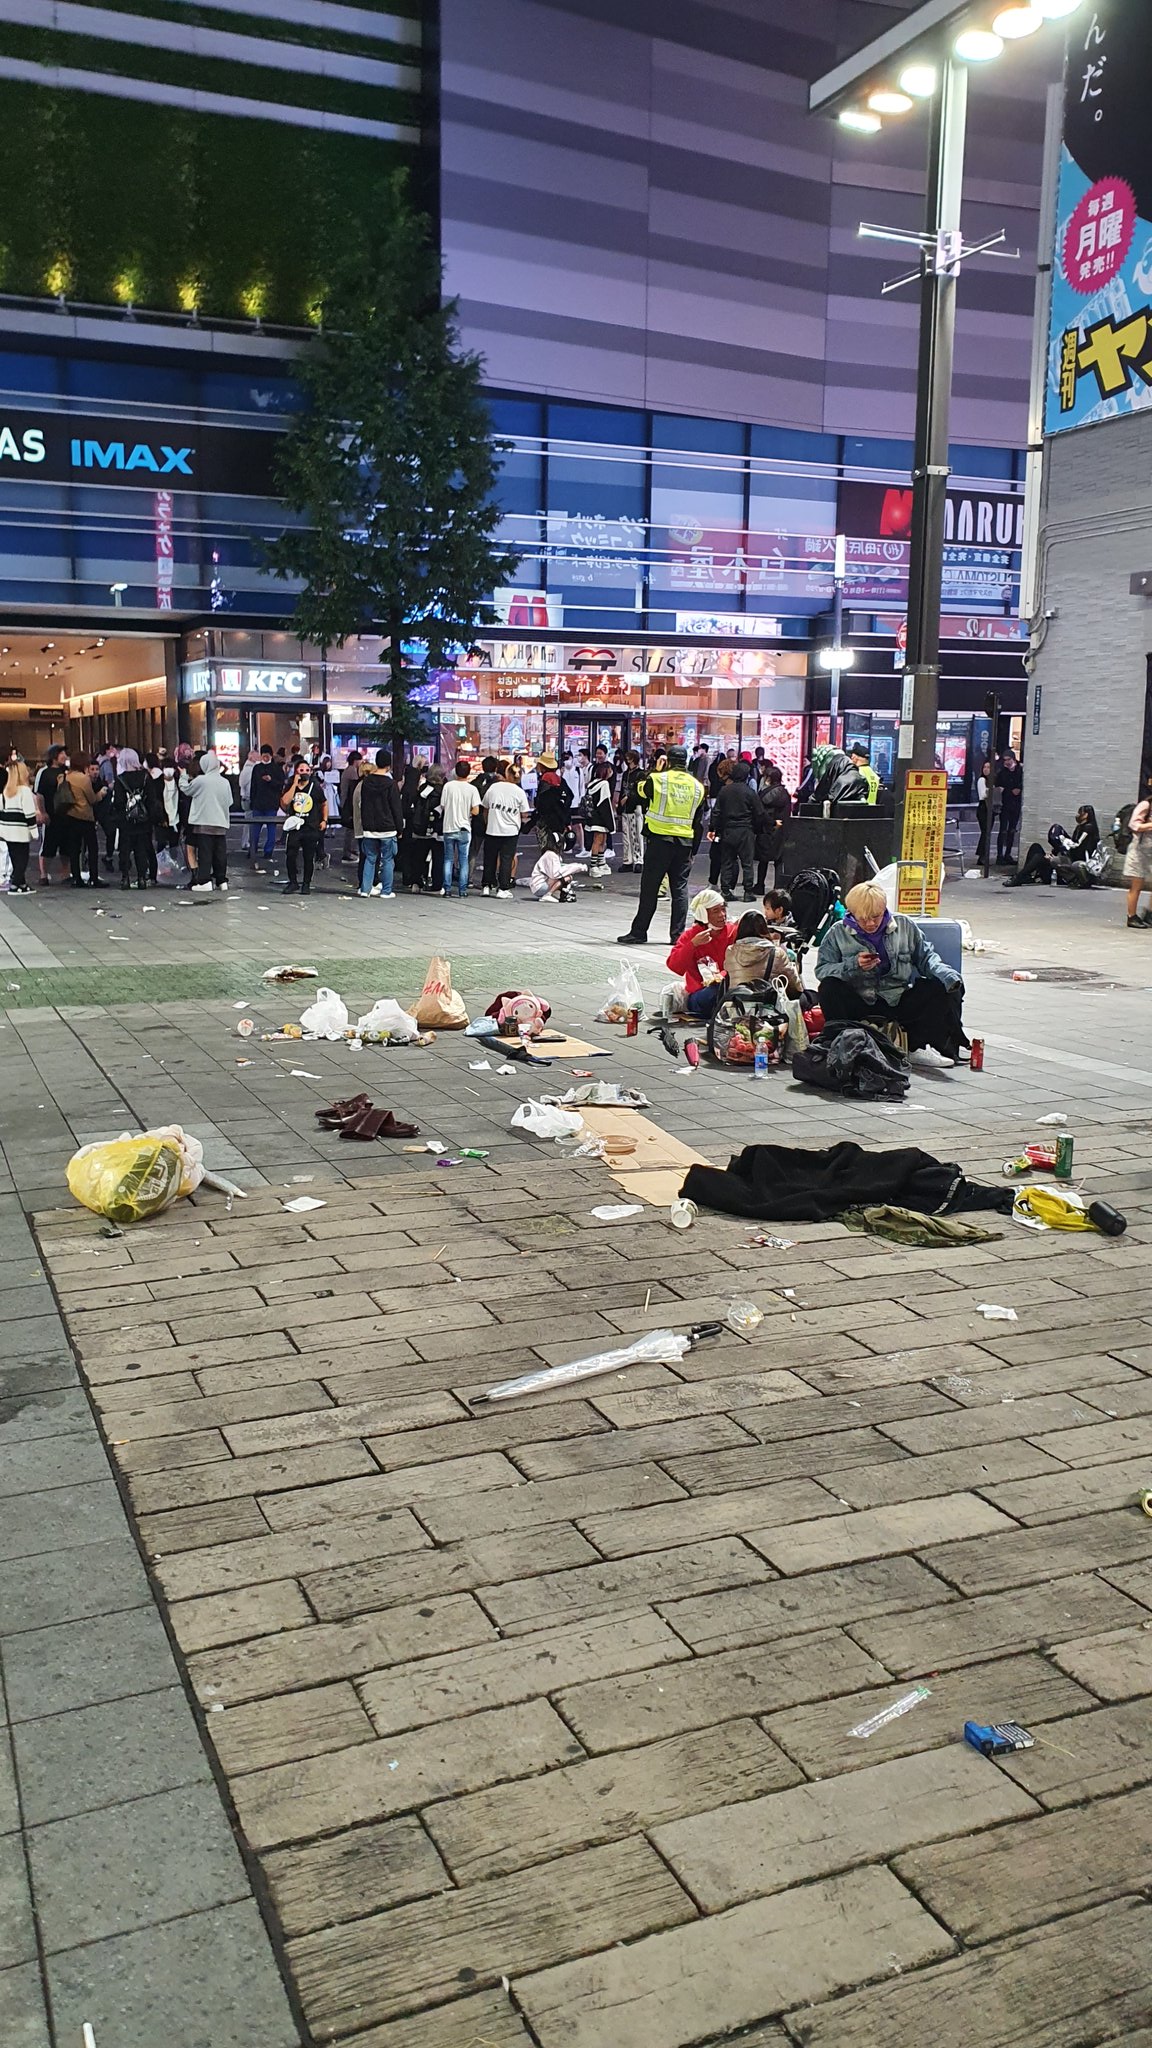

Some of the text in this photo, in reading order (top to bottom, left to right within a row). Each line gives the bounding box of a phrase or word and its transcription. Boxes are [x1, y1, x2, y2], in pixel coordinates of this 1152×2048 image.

[1082, 13, 1106, 121] んだ。
[1088, 191, 1114, 217] 毎週
[1075, 209, 1123, 261] 月曜
[1078, 315, 1152, 391] ヤ
[0, 426, 46, 462] AS
[71, 439, 194, 475] IMAX
[246, 670, 303, 693] KFC
[550, 673, 632, 696] 板前寿司
[914, 774, 940, 786] 警告
